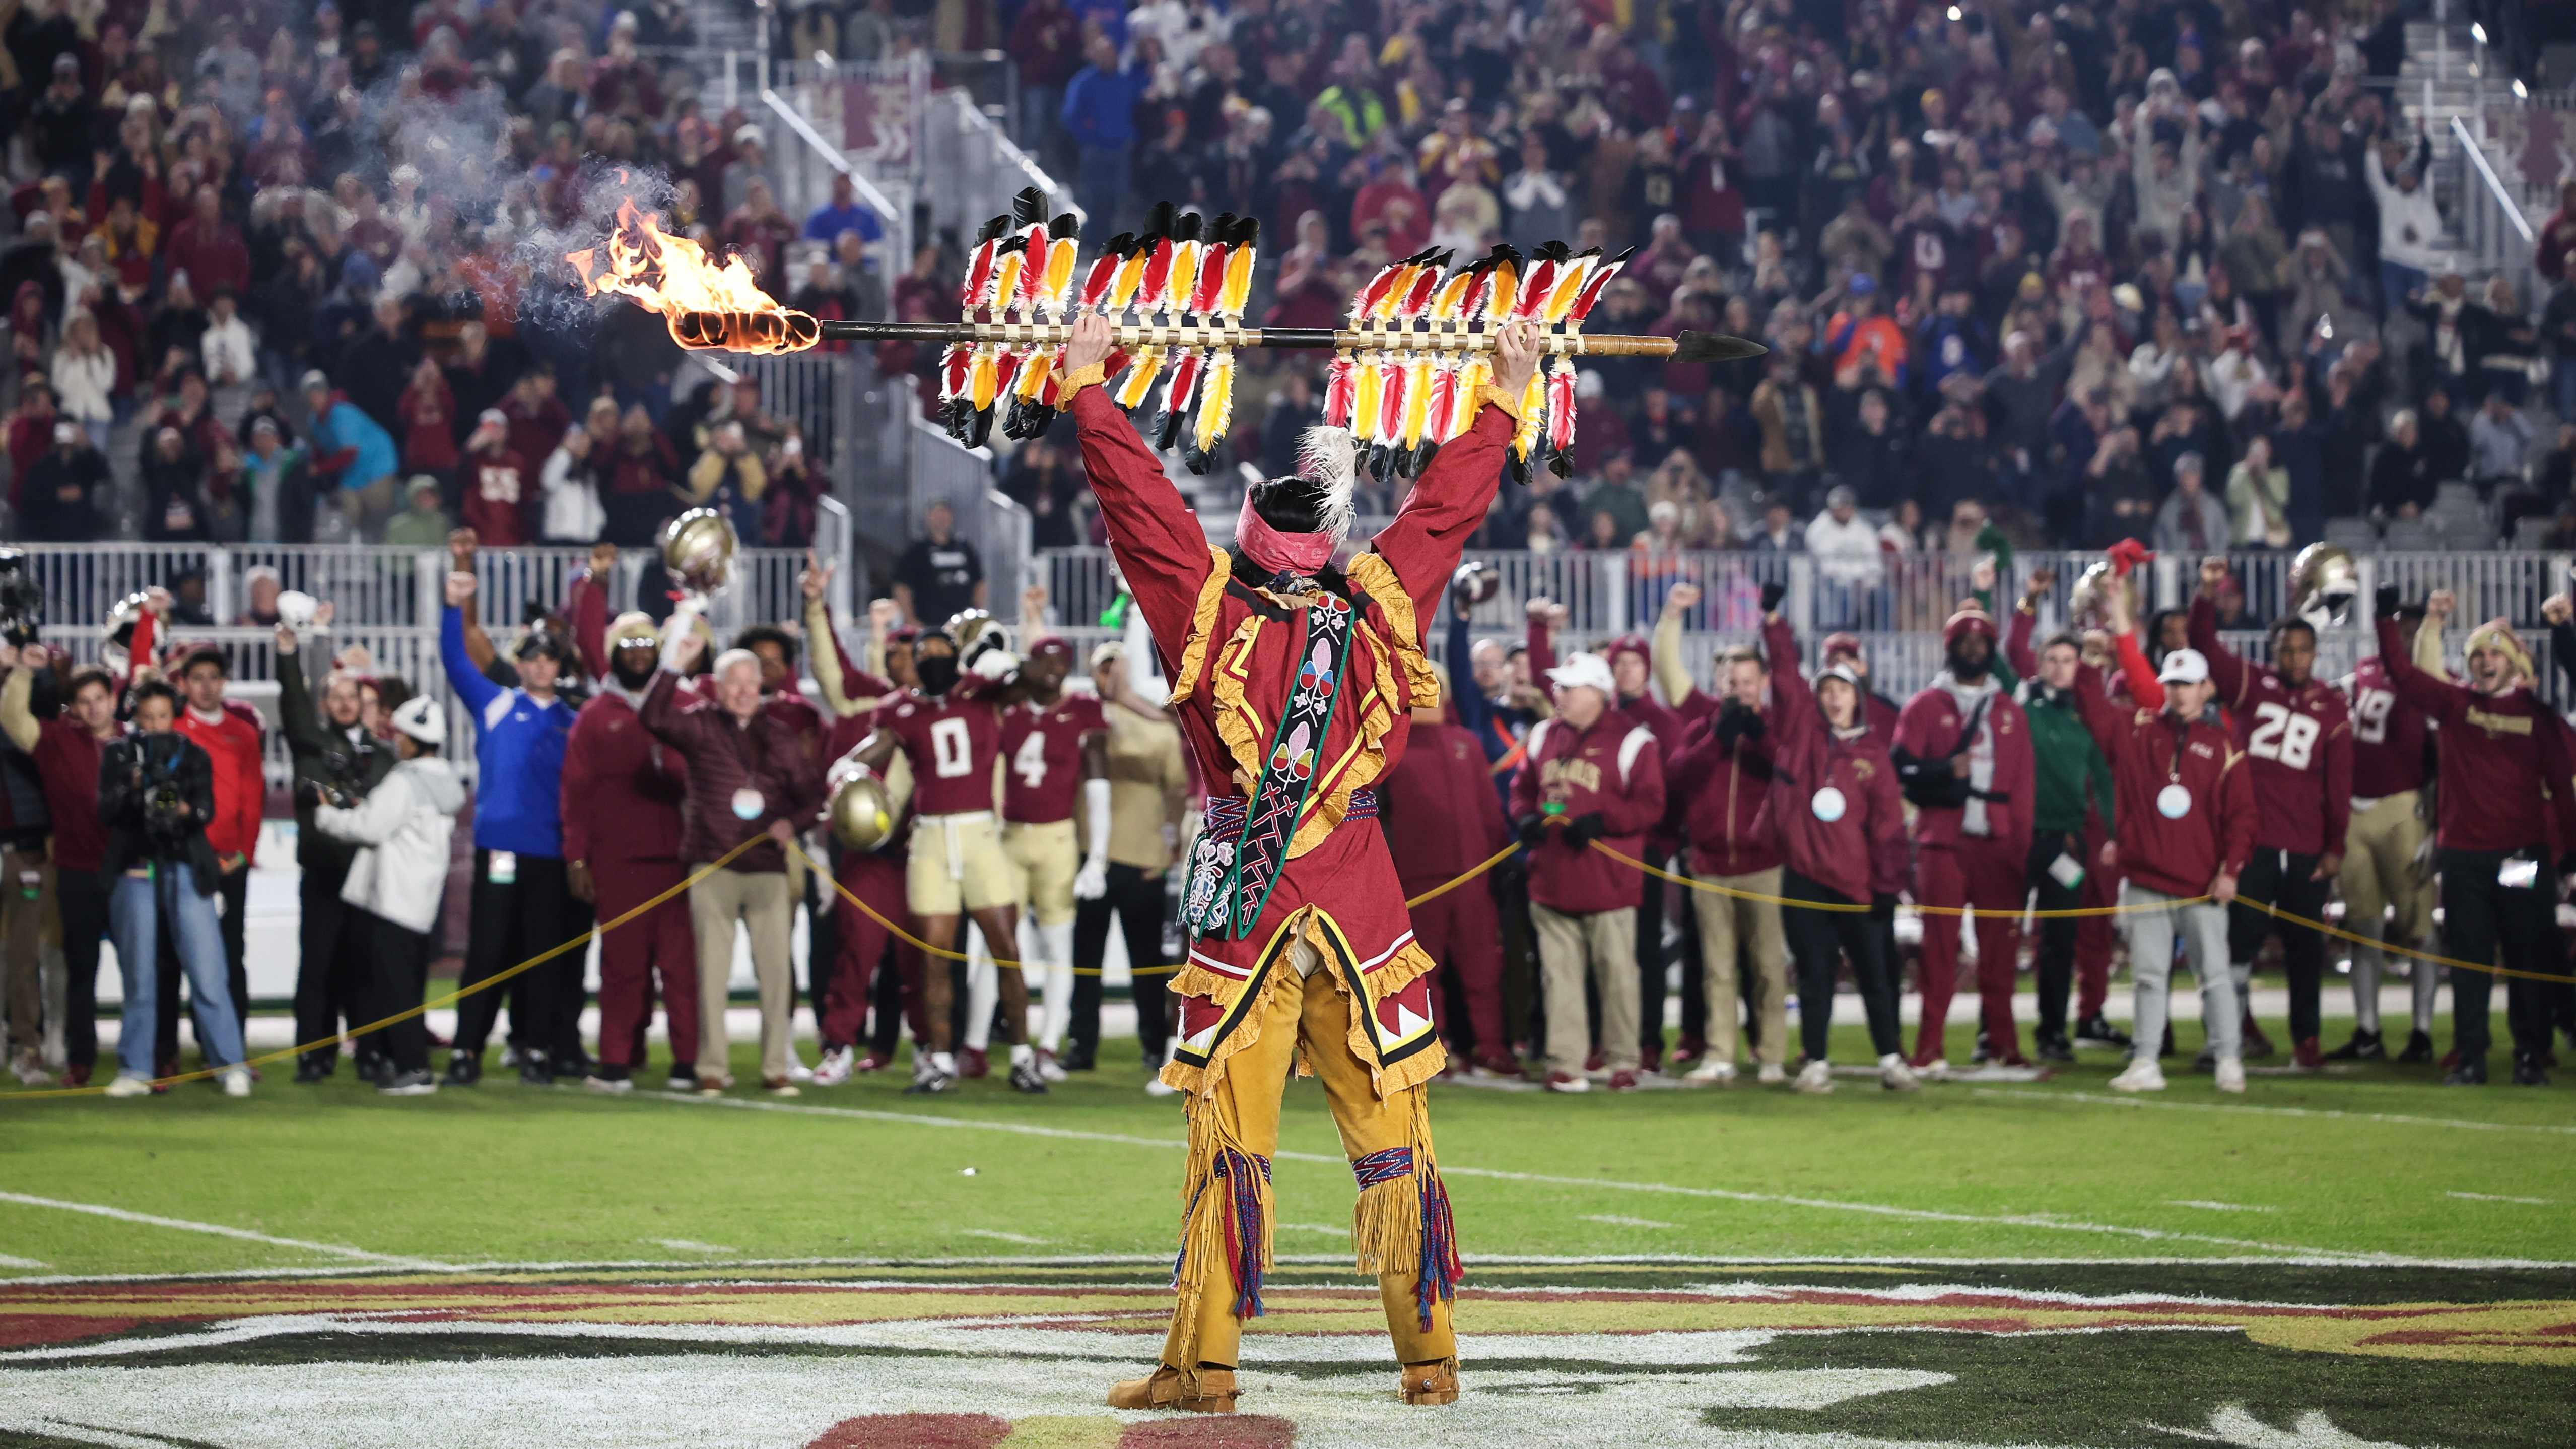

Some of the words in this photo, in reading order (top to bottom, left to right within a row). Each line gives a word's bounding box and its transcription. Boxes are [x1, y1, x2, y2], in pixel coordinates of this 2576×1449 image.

[930, 717, 972, 778] 0
[1014, 731, 1047, 788] 4
[2248, 701, 2321, 770] 28
